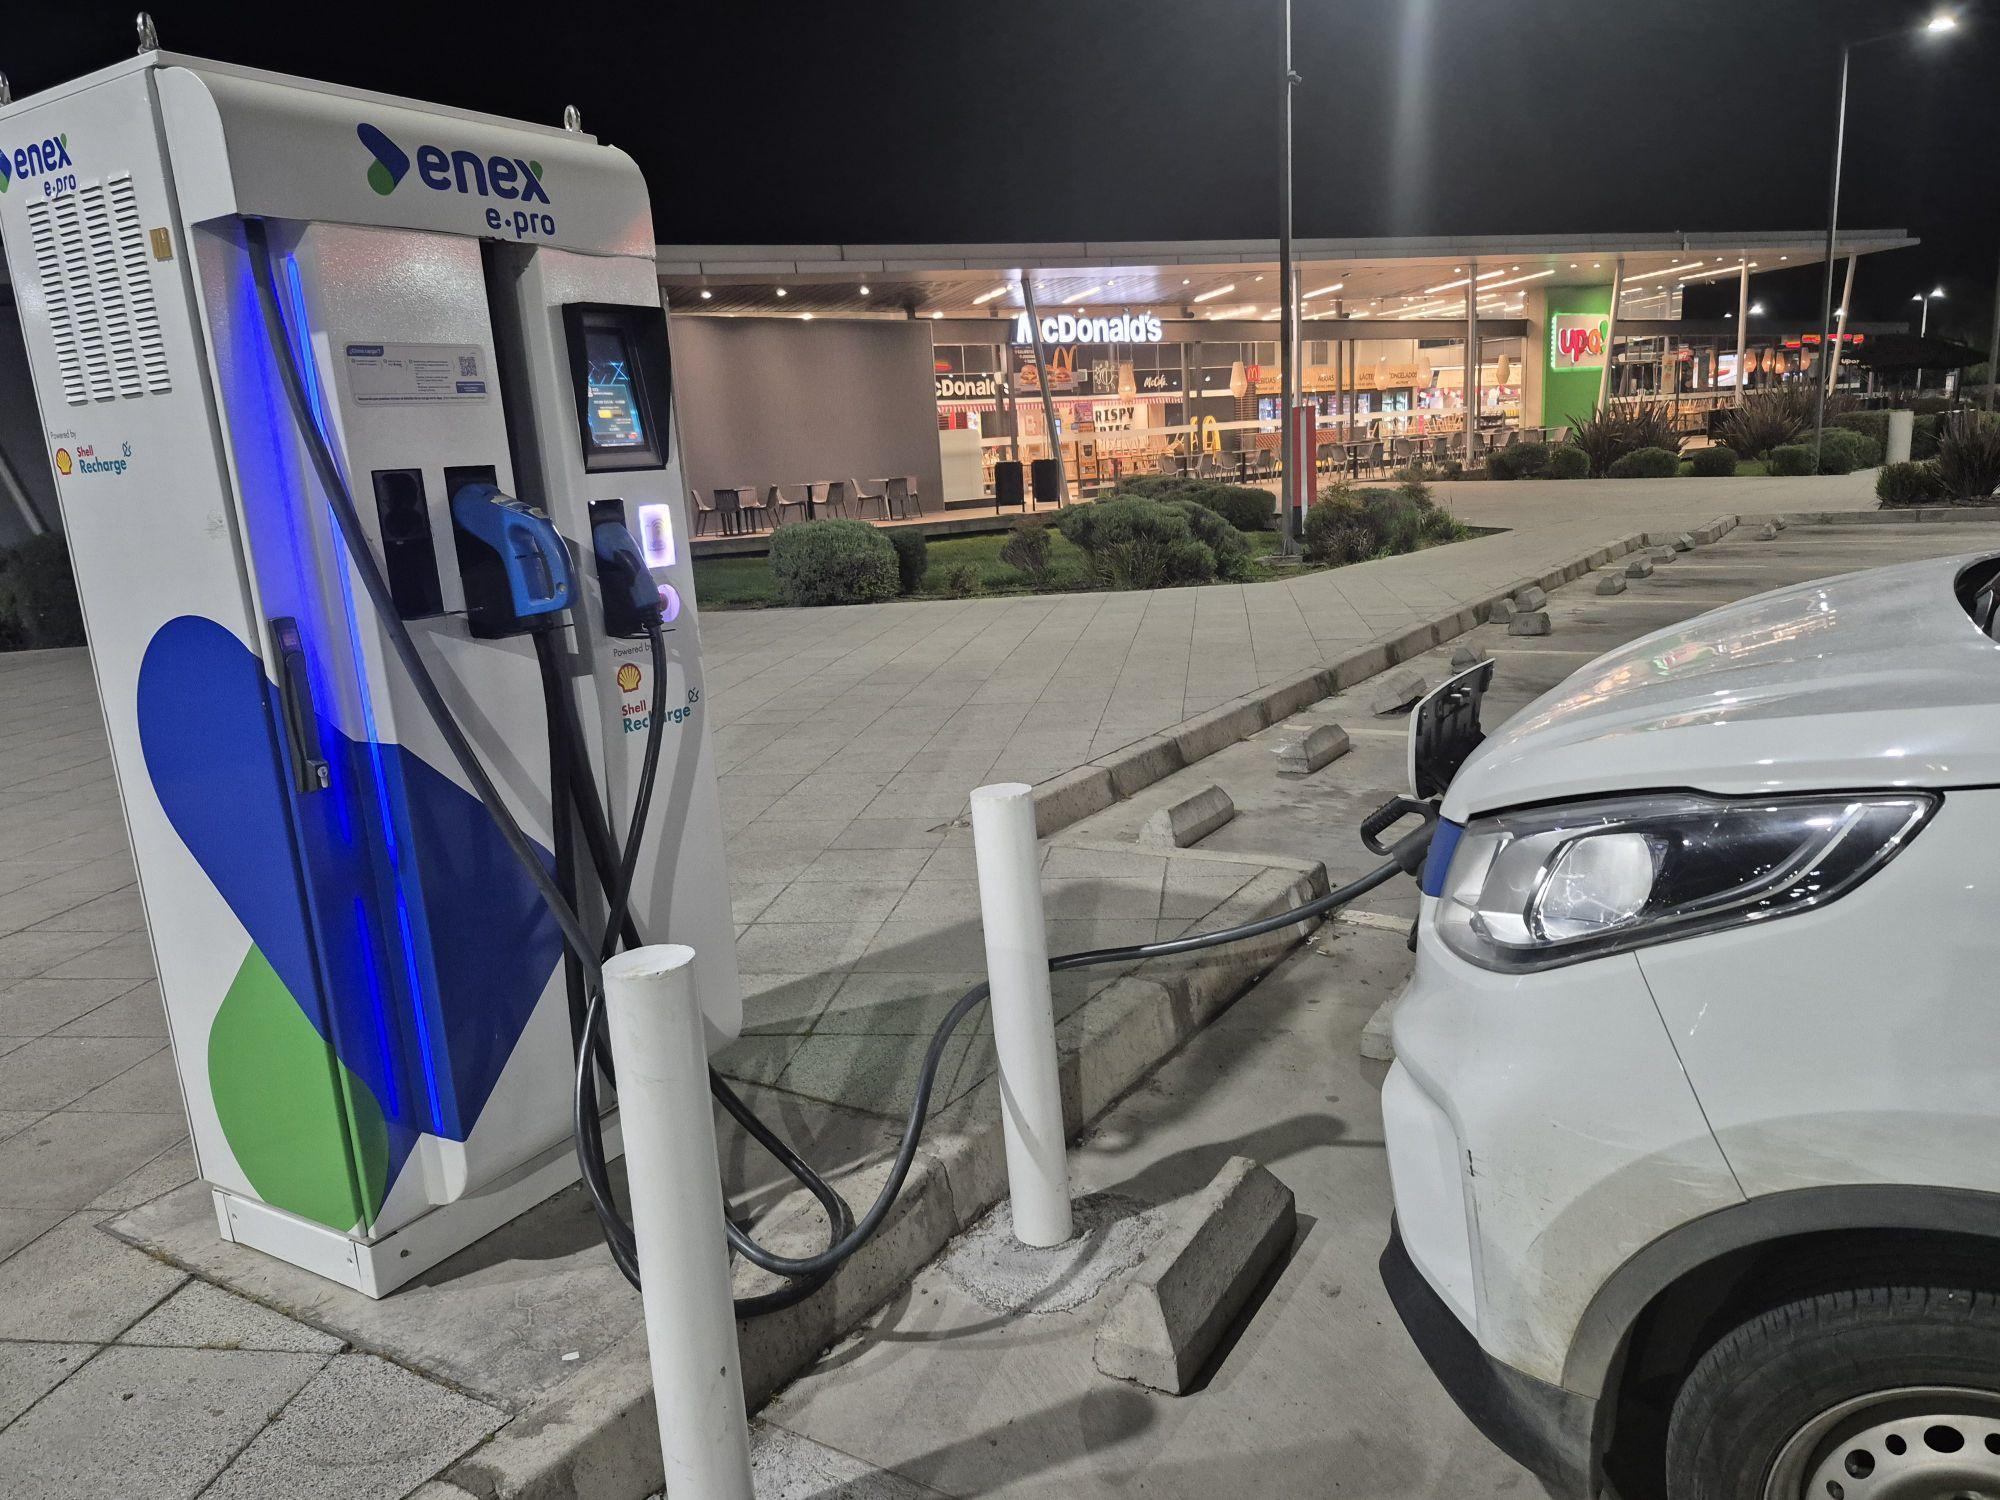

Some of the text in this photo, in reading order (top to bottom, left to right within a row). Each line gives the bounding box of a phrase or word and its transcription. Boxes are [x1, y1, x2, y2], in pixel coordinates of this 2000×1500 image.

[14, 133, 73, 180] enex
[416, 145, 551, 205] enex
[1016, 312, 1163, 343] McDonald's
[1095, 406, 1135, 424] RISPY
[77, 444, 94, 457] Shell
[79, 457, 127, 475] Recharge
[613, 643, 644, 658] Powered
[621, 699, 647, 717] Shell
